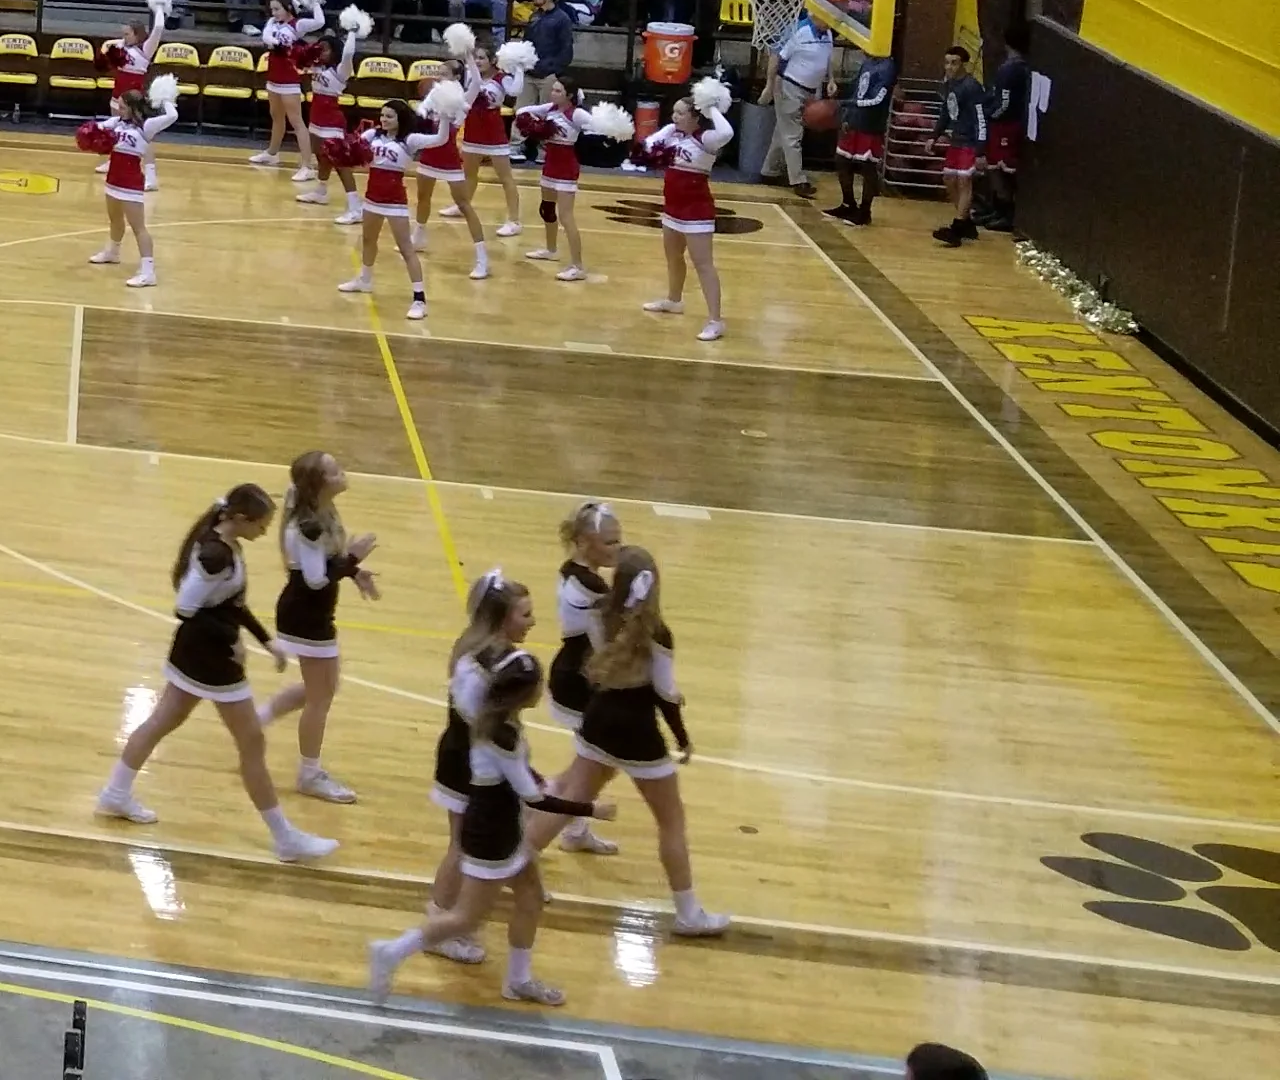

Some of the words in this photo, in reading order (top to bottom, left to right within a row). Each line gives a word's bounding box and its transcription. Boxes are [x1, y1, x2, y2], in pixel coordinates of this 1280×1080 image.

[161, 46, 194, 54] KENTON
[215, 50, 248, 58] KENTON
[962, 315, 1280, 502] KENTON
